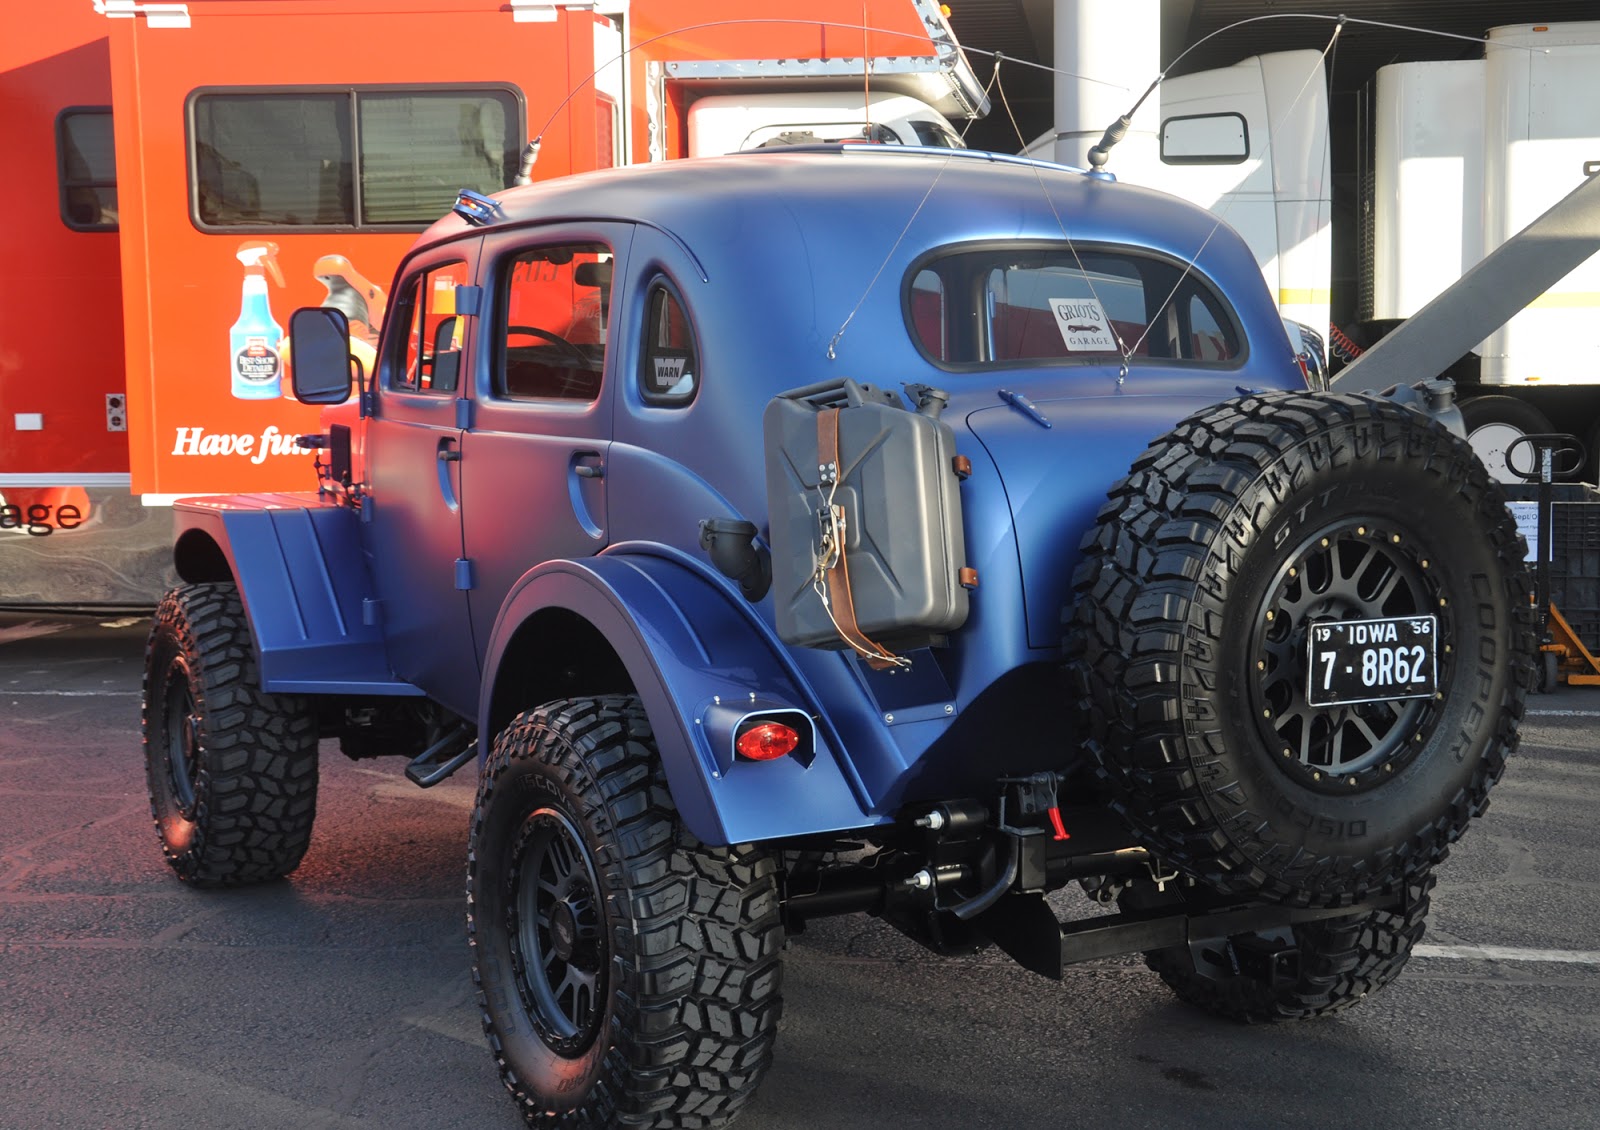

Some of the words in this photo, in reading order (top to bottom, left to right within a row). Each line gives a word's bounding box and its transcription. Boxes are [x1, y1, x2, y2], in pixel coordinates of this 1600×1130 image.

[1057, 302, 1101, 321] GRIOT'S
[1069, 337, 1110, 345] GARAGE
[657, 366, 680, 378] WARN
[172, 427, 254, 456] Have
[0, 504, 81, 537] age
[1316, 628, 1331, 642] 19
[1348, 623, 1398, 645] IOWA
[1413, 621, 1430, 634] 56
[1321, 651, 1337, 690] 7
[1362, 645, 1426, 687] 8R62
